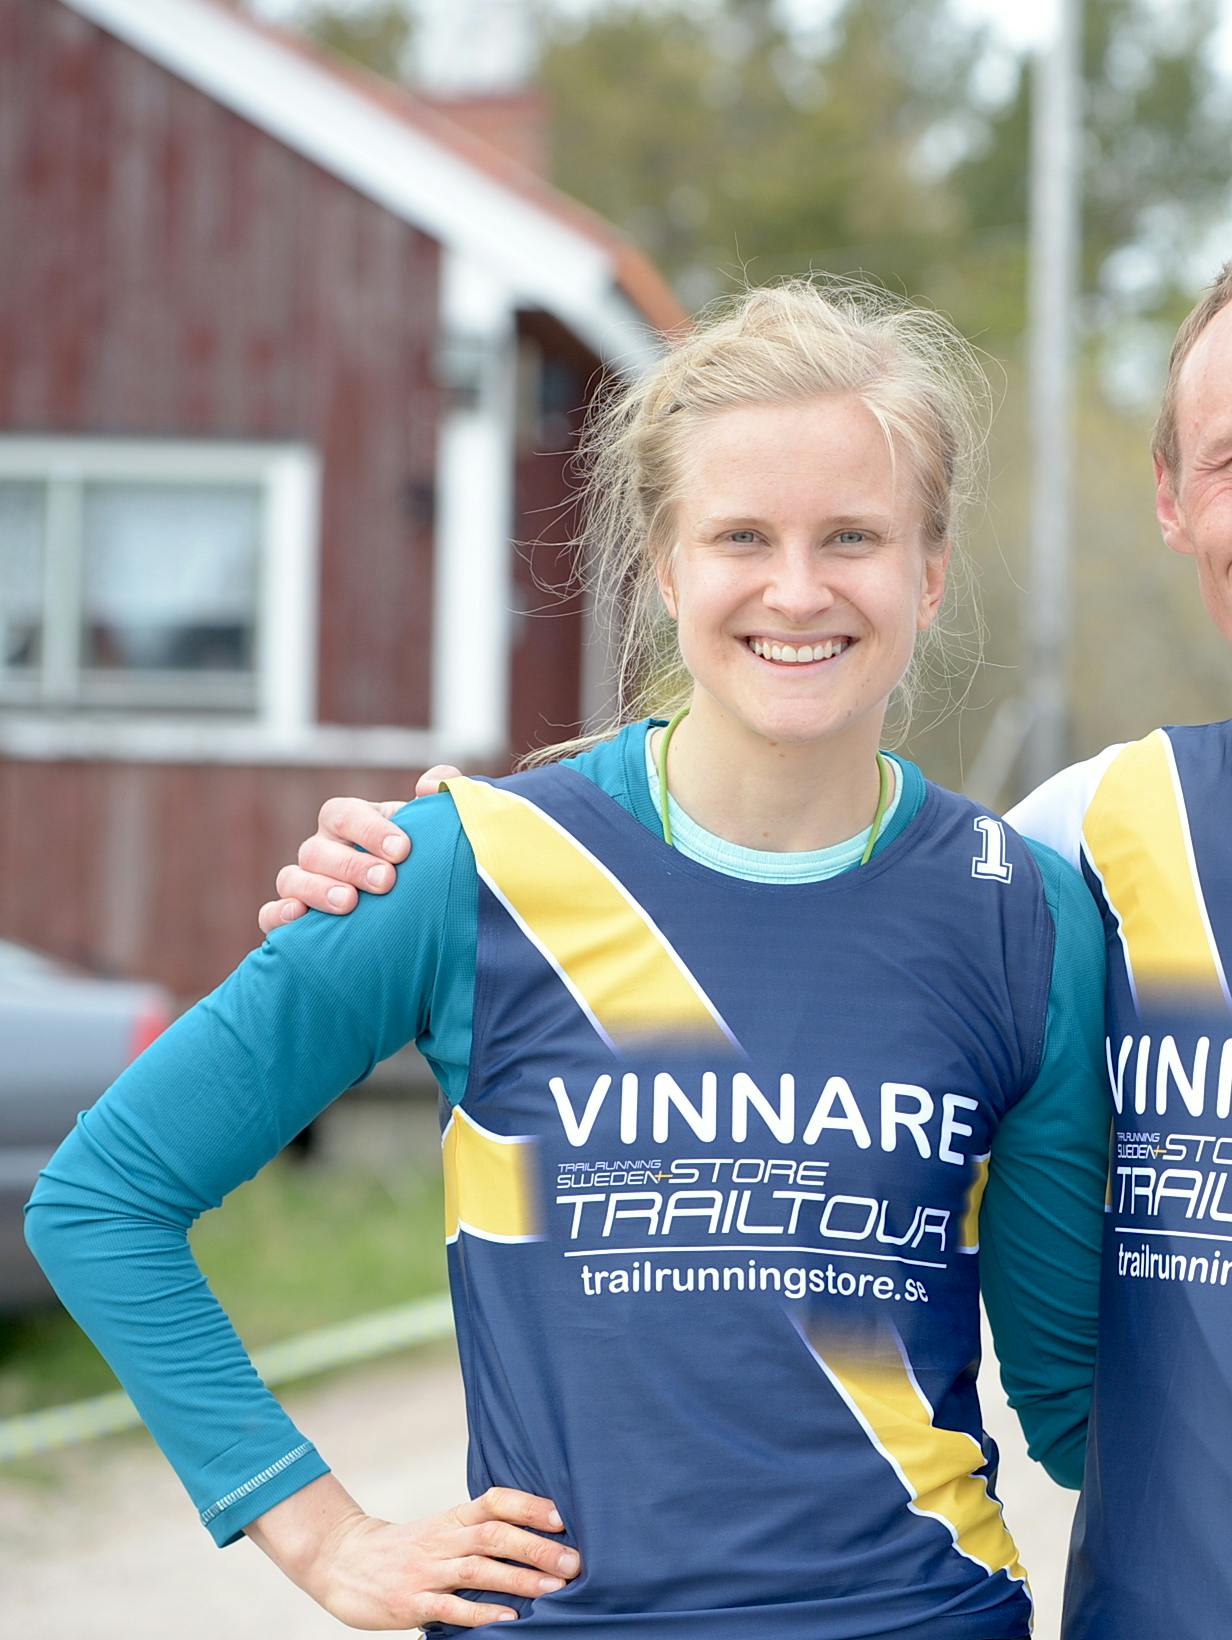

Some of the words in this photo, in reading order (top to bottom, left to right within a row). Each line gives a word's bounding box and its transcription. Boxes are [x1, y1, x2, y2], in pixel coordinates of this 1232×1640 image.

[971, 815, 1014, 885] 1
[548, 1071, 980, 1165] VINNARE
[556, 1170, 662, 1189] SWEDEN
[668, 1158, 830, 1186] STORE
[557, 1159, 662, 1173] TRAILRUNNING
[556, 1189, 951, 1252] TRAILTOUR
[581, 1259, 929, 1302] trailrunningstore.se
